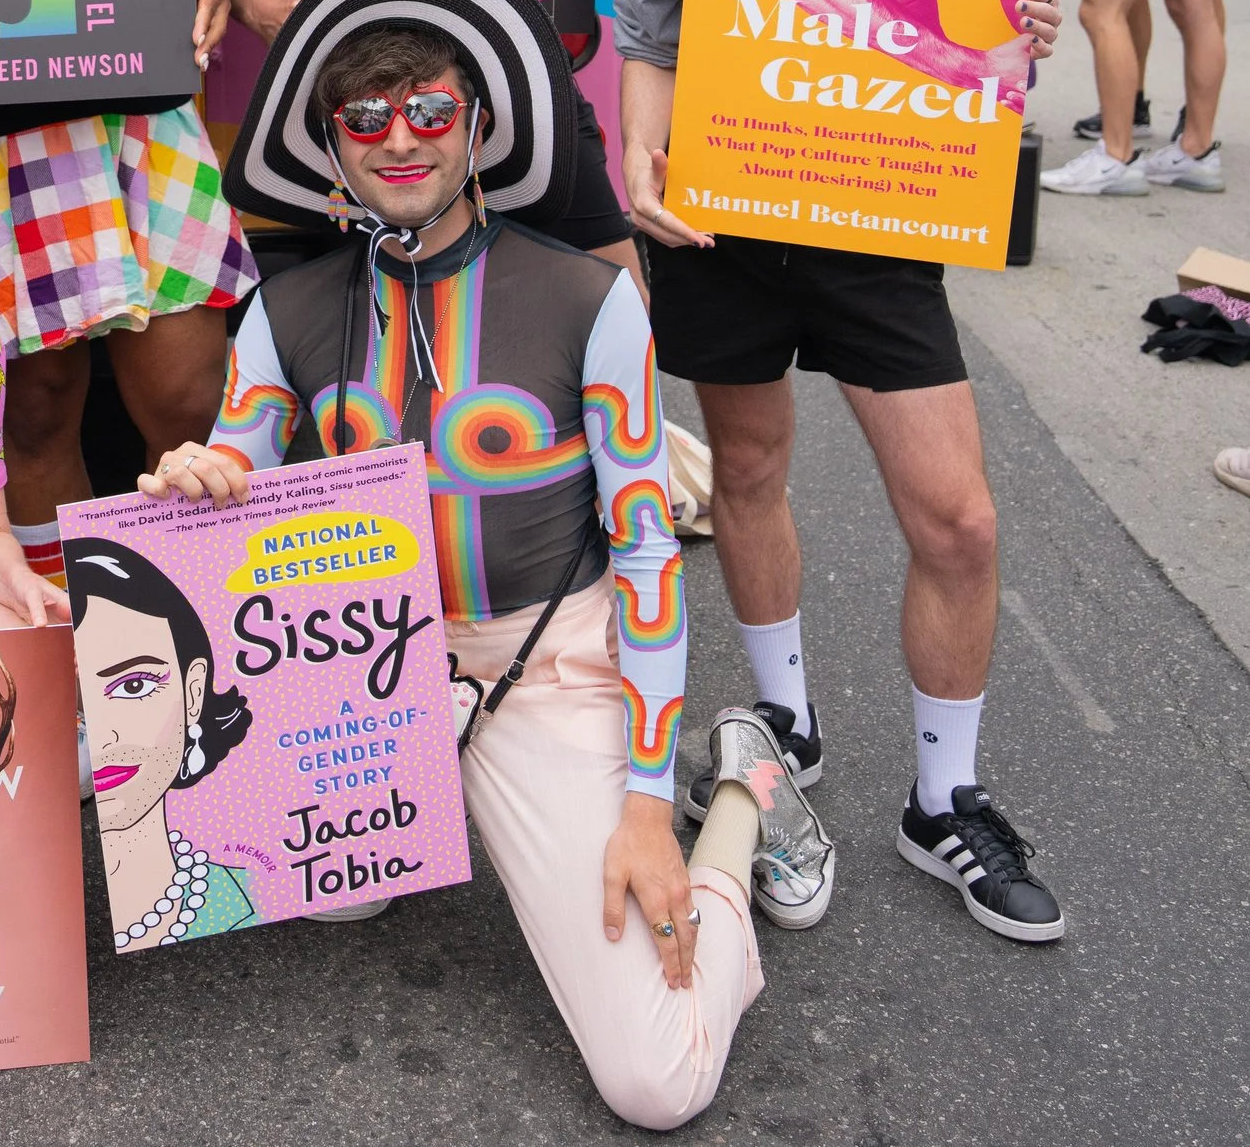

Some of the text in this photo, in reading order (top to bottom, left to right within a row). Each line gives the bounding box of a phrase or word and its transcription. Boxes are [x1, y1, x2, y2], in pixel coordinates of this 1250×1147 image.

[48, 52, 144, 79] NEWSON
[760, 56, 1001, 125] Gazed
[711, 113, 977, 155] On Hunks, Heartthrobs, and
[705, 135, 979, 180] What Pop Culture Taught Me
[738, 162, 938, 198] About (Desiring) Men
[684, 187, 991, 245] Manuel Betancourt
[177, 494, 187, 505] If
[252, 483, 263, 491] to
[265, 479, 281, 489] the
[283, 474, 310, 486] ranks
[312, 471, 322, 481] of
[324, 467, 353, 479] comic
[355, 456, 409, 473] memoirists
[118, 519, 136, 529] like
[138, 509, 174, 526] David
[225, 502, 243, 510] and
[246, 492, 283, 507] Mindy
[286, 484, 327, 499] Kaling,
[329, 480, 354, 492] Sissy
[196, 520, 218, 529] New
[220, 515, 242, 525] York
[244, 510, 273, 521] Times
[275, 505, 299, 515] Book
[302, 497, 337, 510] Review
[261, 517, 383, 555] NATIONAL
[252, 543, 399, 588] BESTSELLER
[231, 593, 436, 701] Sissy
[277, 707, 427, 749] COMING-OF-
[339, 700, 355, 716] A
[297, 739, 398, 773] GENDER
[313, 765, 393, 795] STORY
[281, 788, 418, 854] Jacob
[222, 843, 277, 874] A MEMOIR
[289, 850, 424, 904] Tobia
